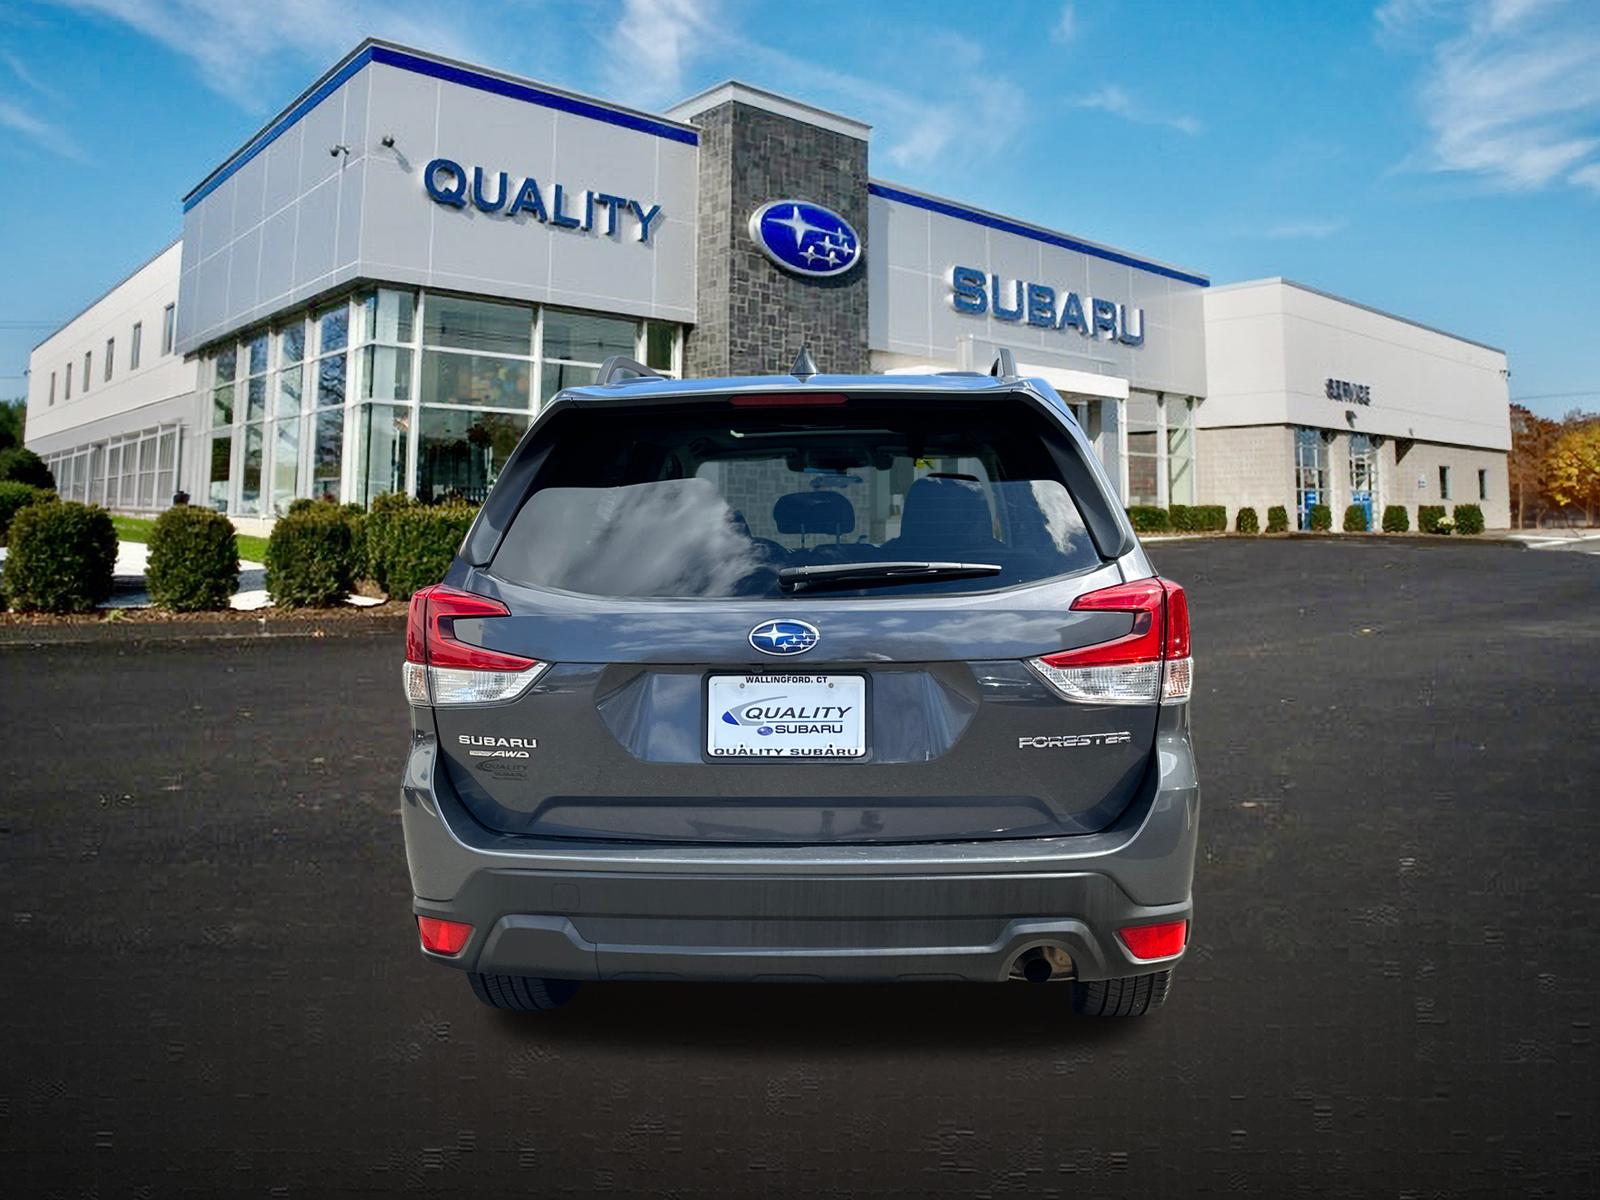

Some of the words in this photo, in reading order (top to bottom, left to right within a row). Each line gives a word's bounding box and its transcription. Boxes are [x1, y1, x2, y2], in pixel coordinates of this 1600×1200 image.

[424, 158, 662, 242] QUALITY
[950, 265, 1145, 346] SUBARU
[816, 676, 828, 684] CT
[745, 706, 852, 719] QUALITY
[775, 725, 843, 734] SUBARU
[458, 734, 537, 748] SUBARU
[1018, 731, 1131, 749] FORESTER
[491, 750, 530, 758] AWD
[714, 748, 782, 756] QUALITY
[790, 748, 858, 756] SUBARU
